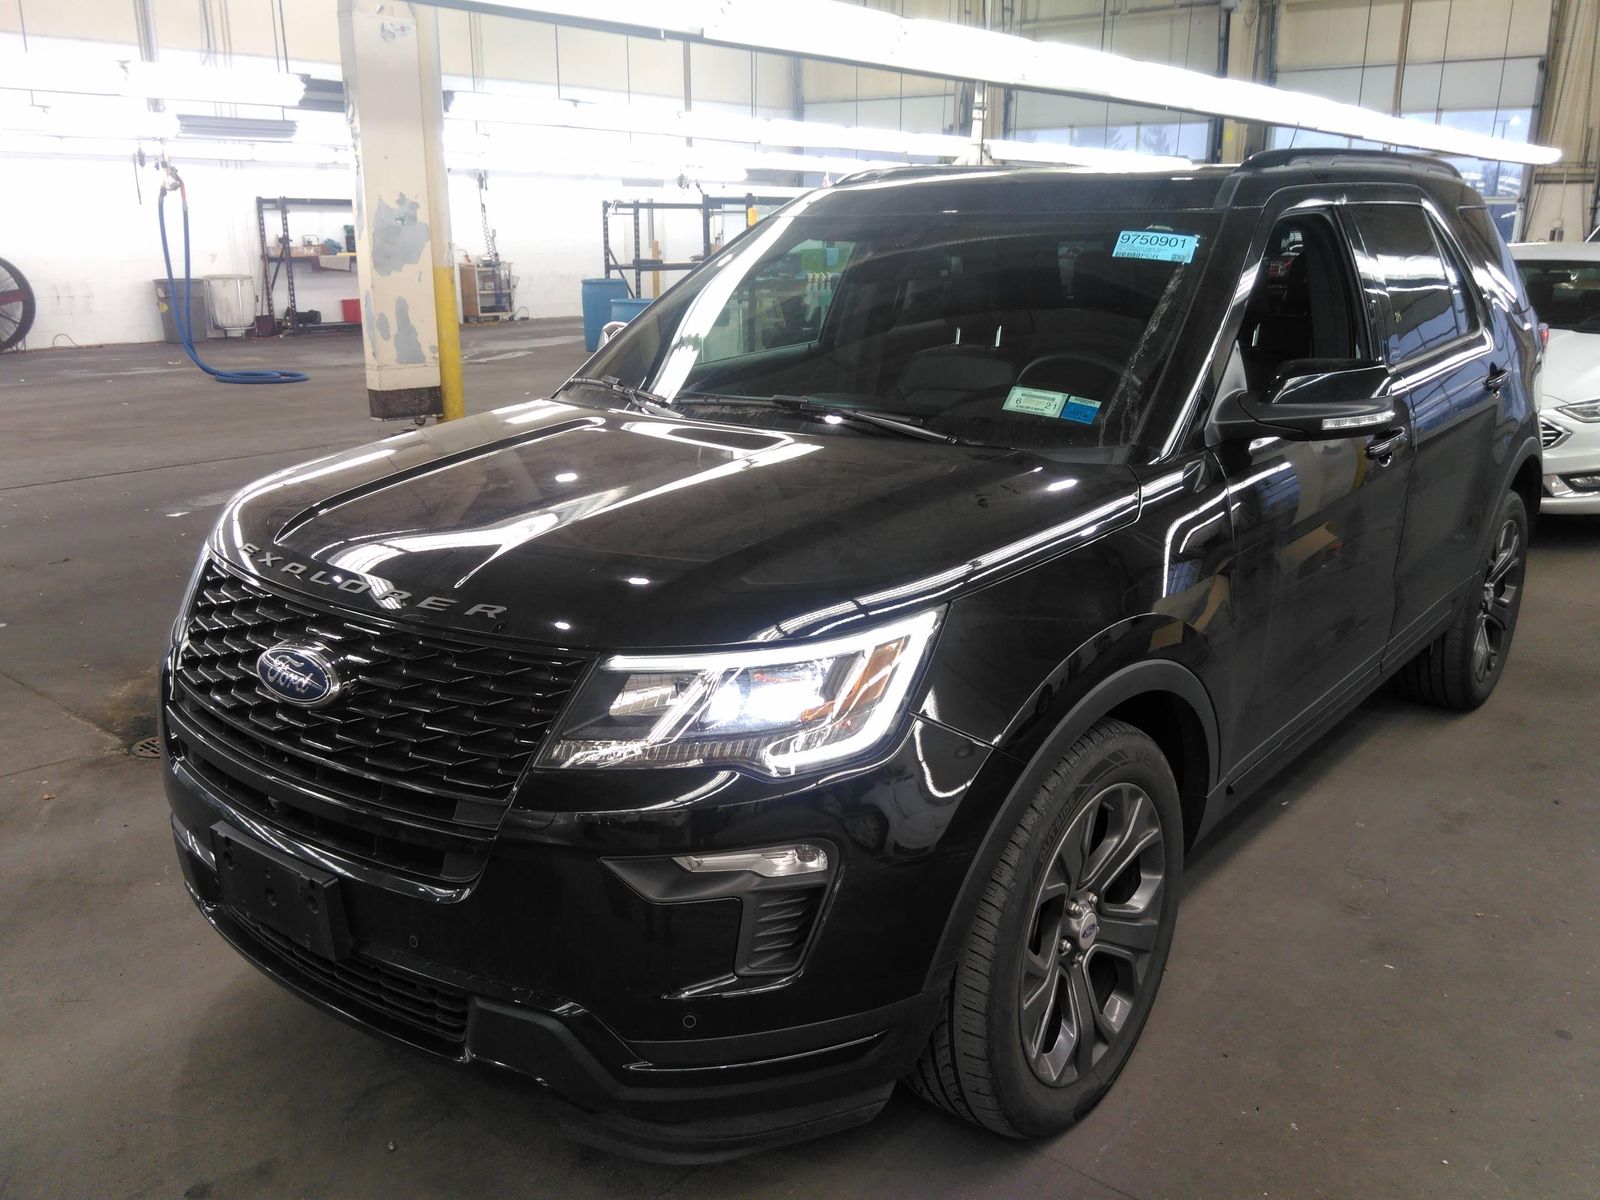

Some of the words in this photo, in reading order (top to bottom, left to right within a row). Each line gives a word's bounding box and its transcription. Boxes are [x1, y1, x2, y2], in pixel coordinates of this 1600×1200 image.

[1120, 233, 1187, 248] 9750901
[1044, 402, 1058, 411] 21
[240, 542, 508, 619] EXPLORER
[266, 654, 326, 694] Ford
